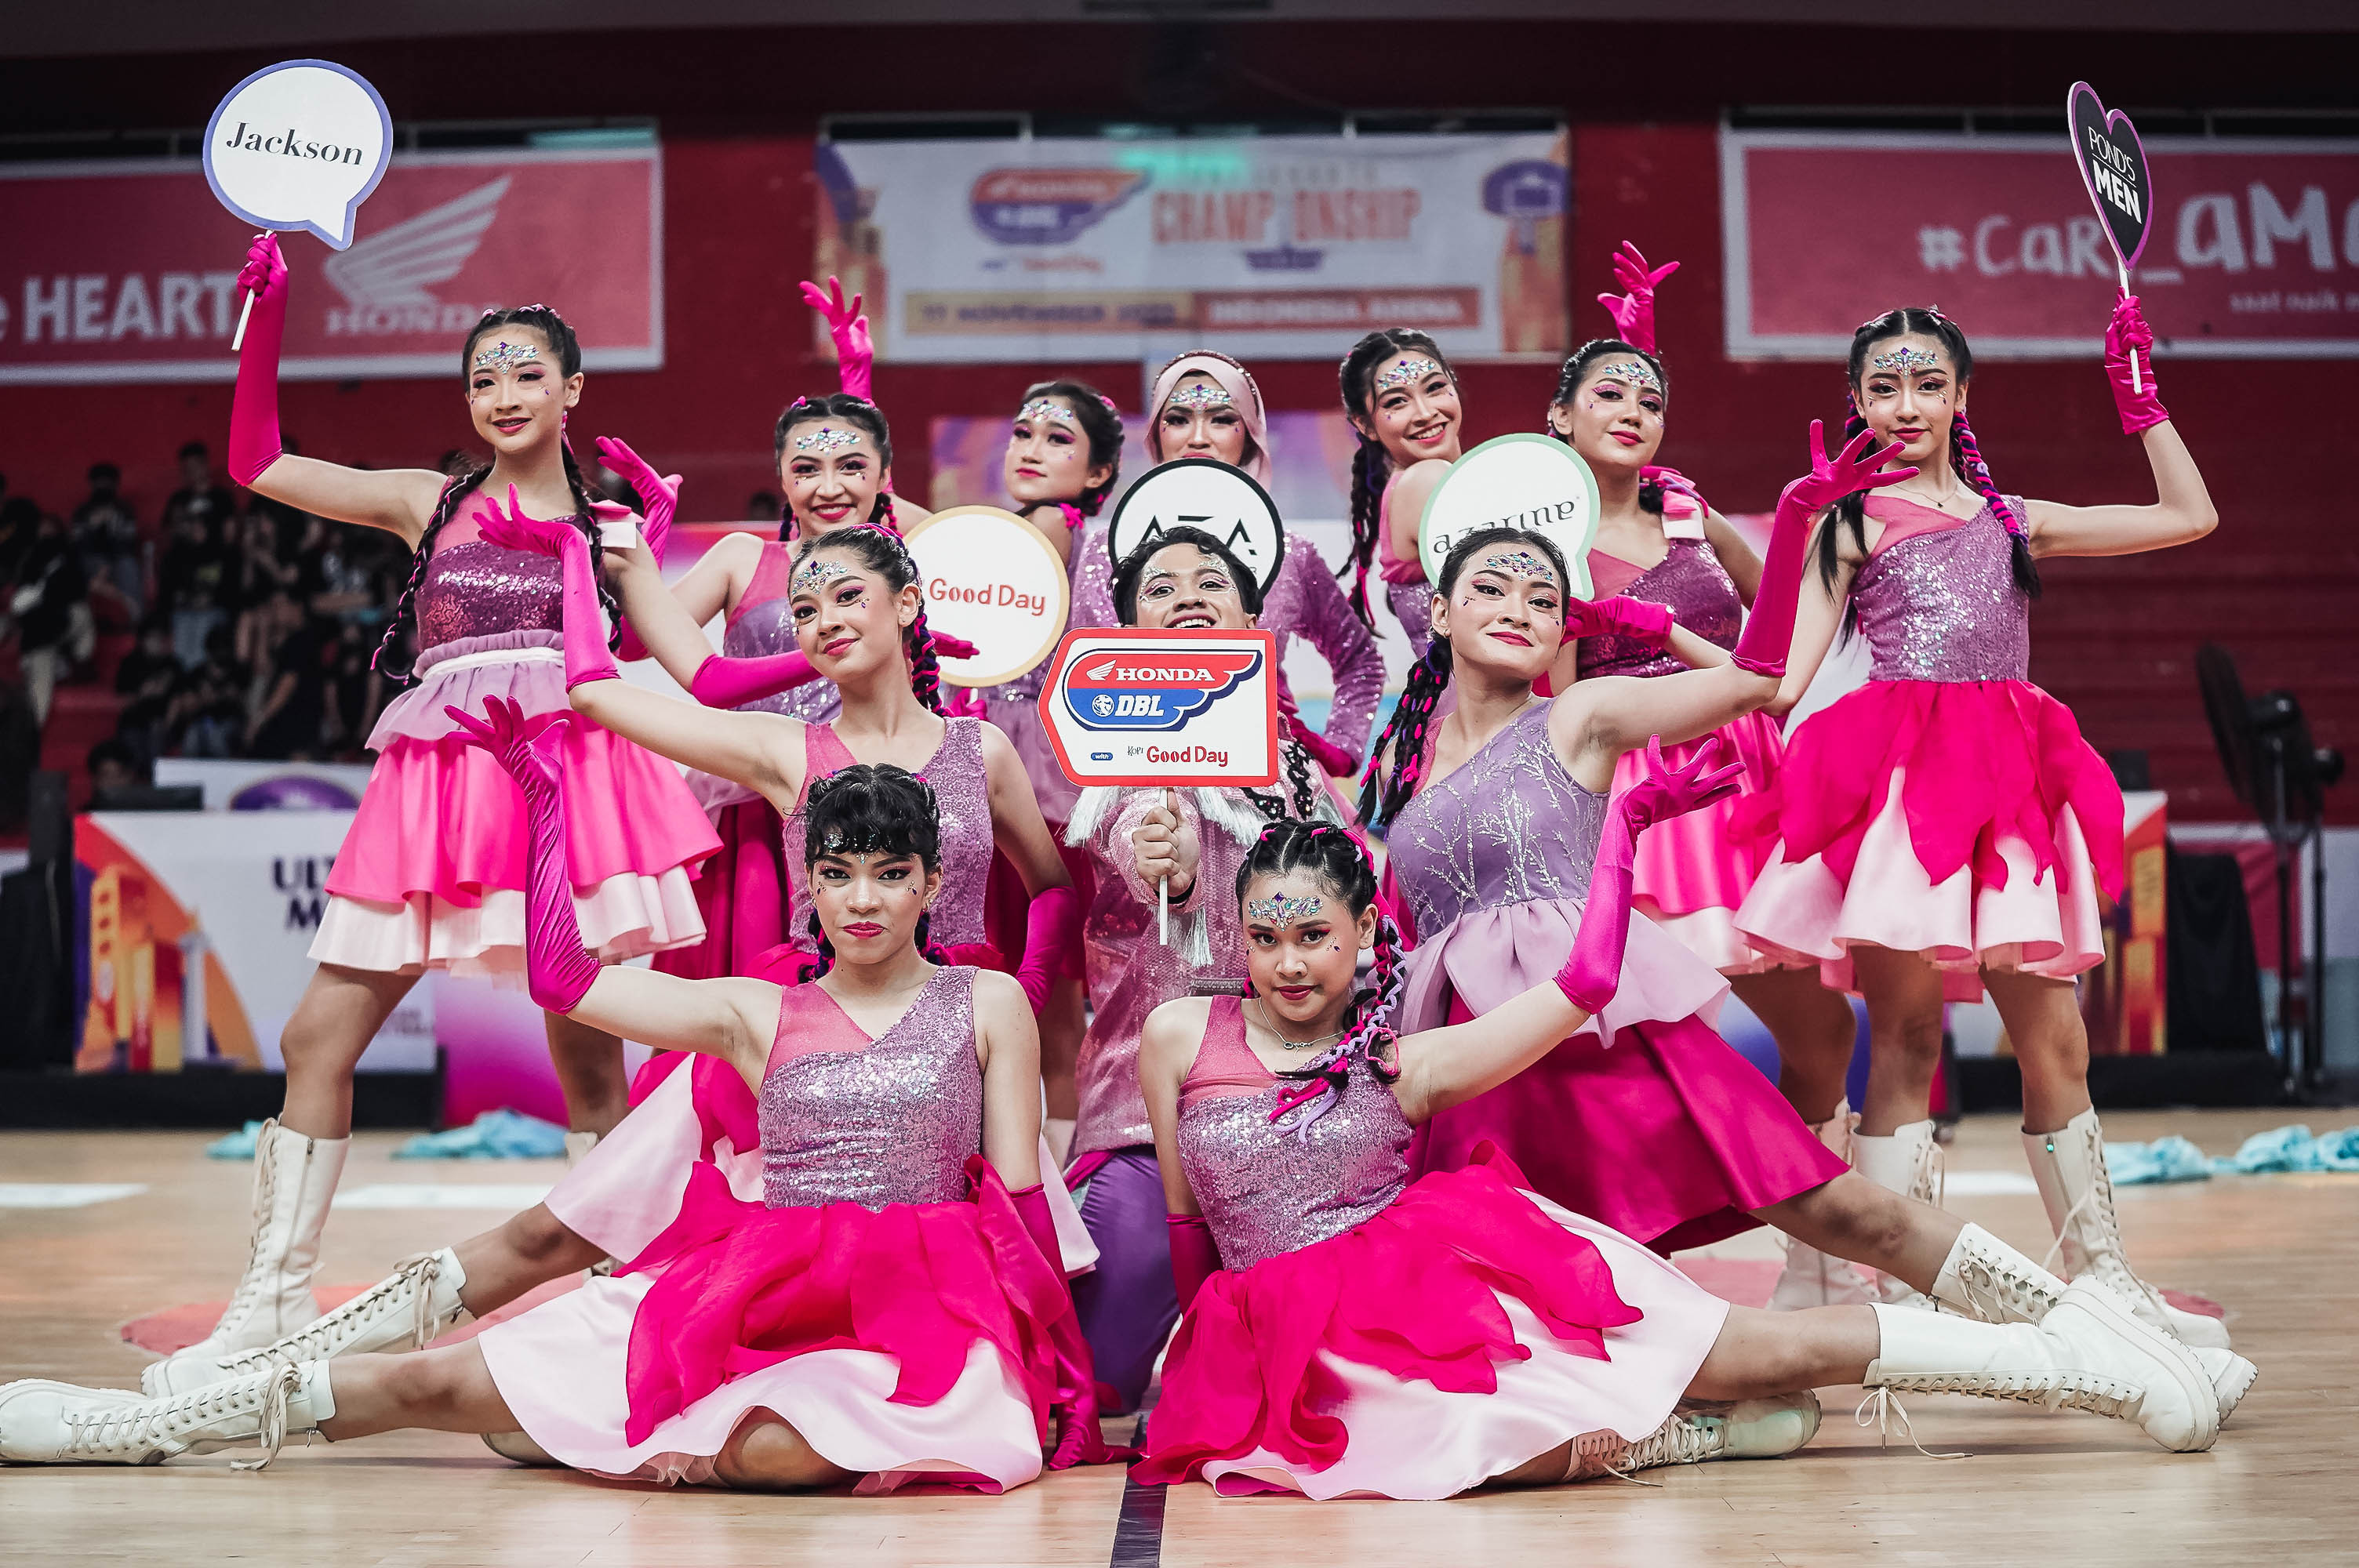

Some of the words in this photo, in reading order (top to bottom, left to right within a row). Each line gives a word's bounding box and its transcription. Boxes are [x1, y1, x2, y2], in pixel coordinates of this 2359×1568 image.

[226, 122, 363, 165] Jackson
[2088, 125, 2135, 181] POND'S
[2092, 159, 2143, 224] MEN
[23, 270, 238, 343] HEART
[929, 578, 993, 604] Good
[998, 584, 1046, 617] Day
[1116, 667, 1216, 682] HONDA
[1114, 694, 1165, 717] DBL
[1146, 746, 1190, 763] Good
[1194, 746, 1228, 768] Day
